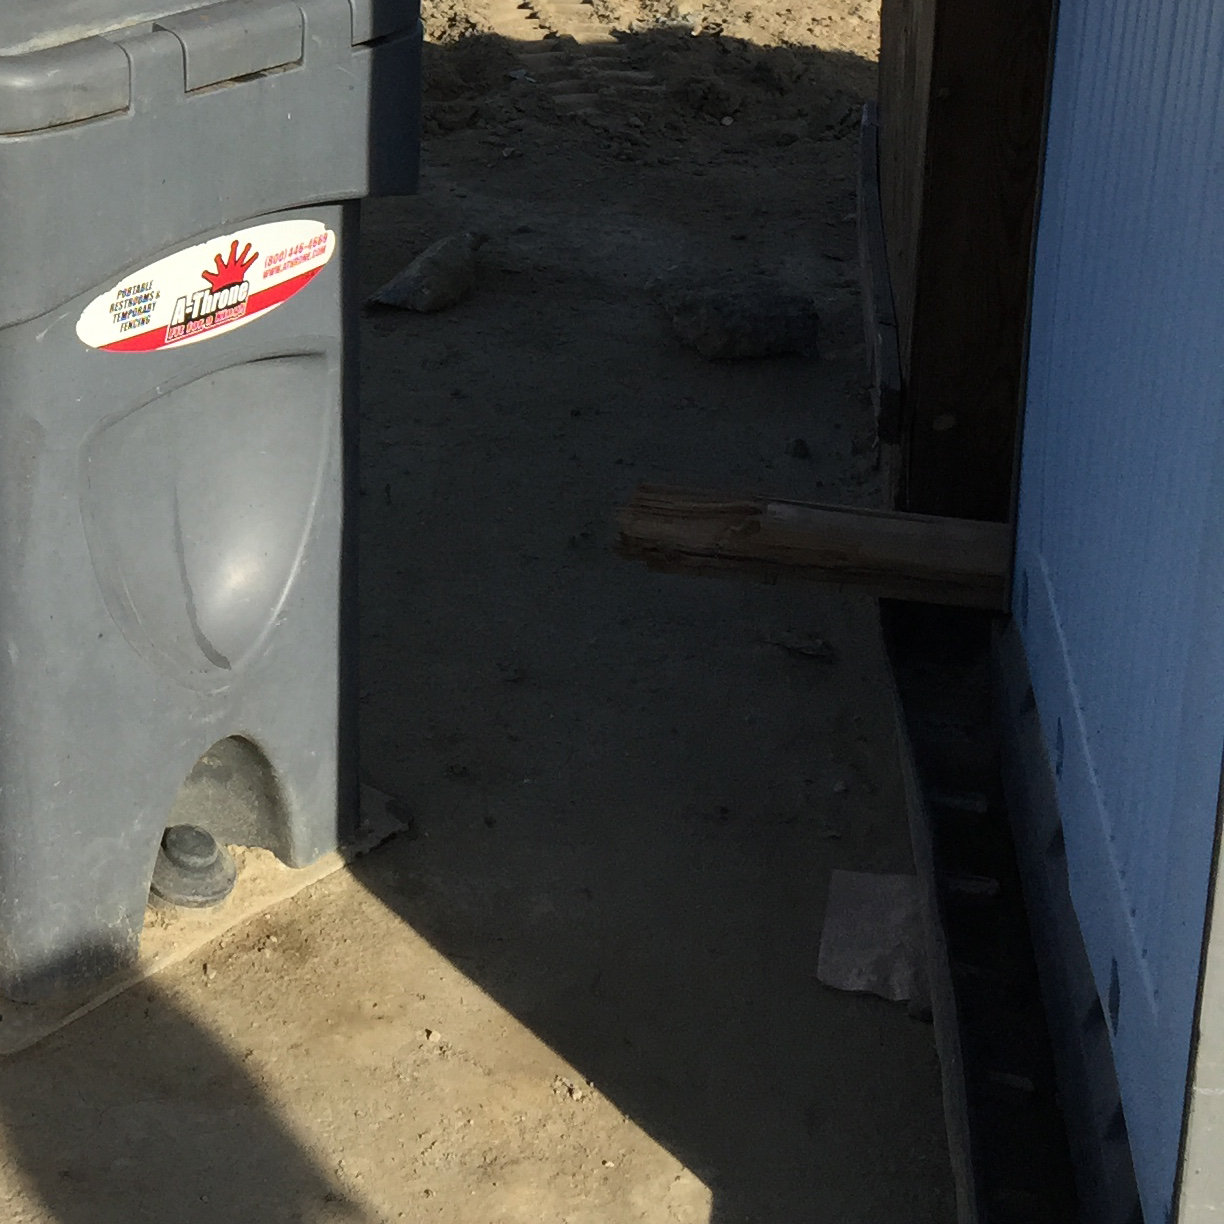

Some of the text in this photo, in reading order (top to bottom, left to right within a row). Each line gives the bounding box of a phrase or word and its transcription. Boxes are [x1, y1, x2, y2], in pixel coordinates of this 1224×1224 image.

[116, 279, 154, 300] PORTABLE
[108, 290, 154, 314] RESTROOMS
[112, 301, 156, 324] TEMPORARY
[170, 280, 249, 328] A-Throne
[120, 314, 151, 333] FENCING
